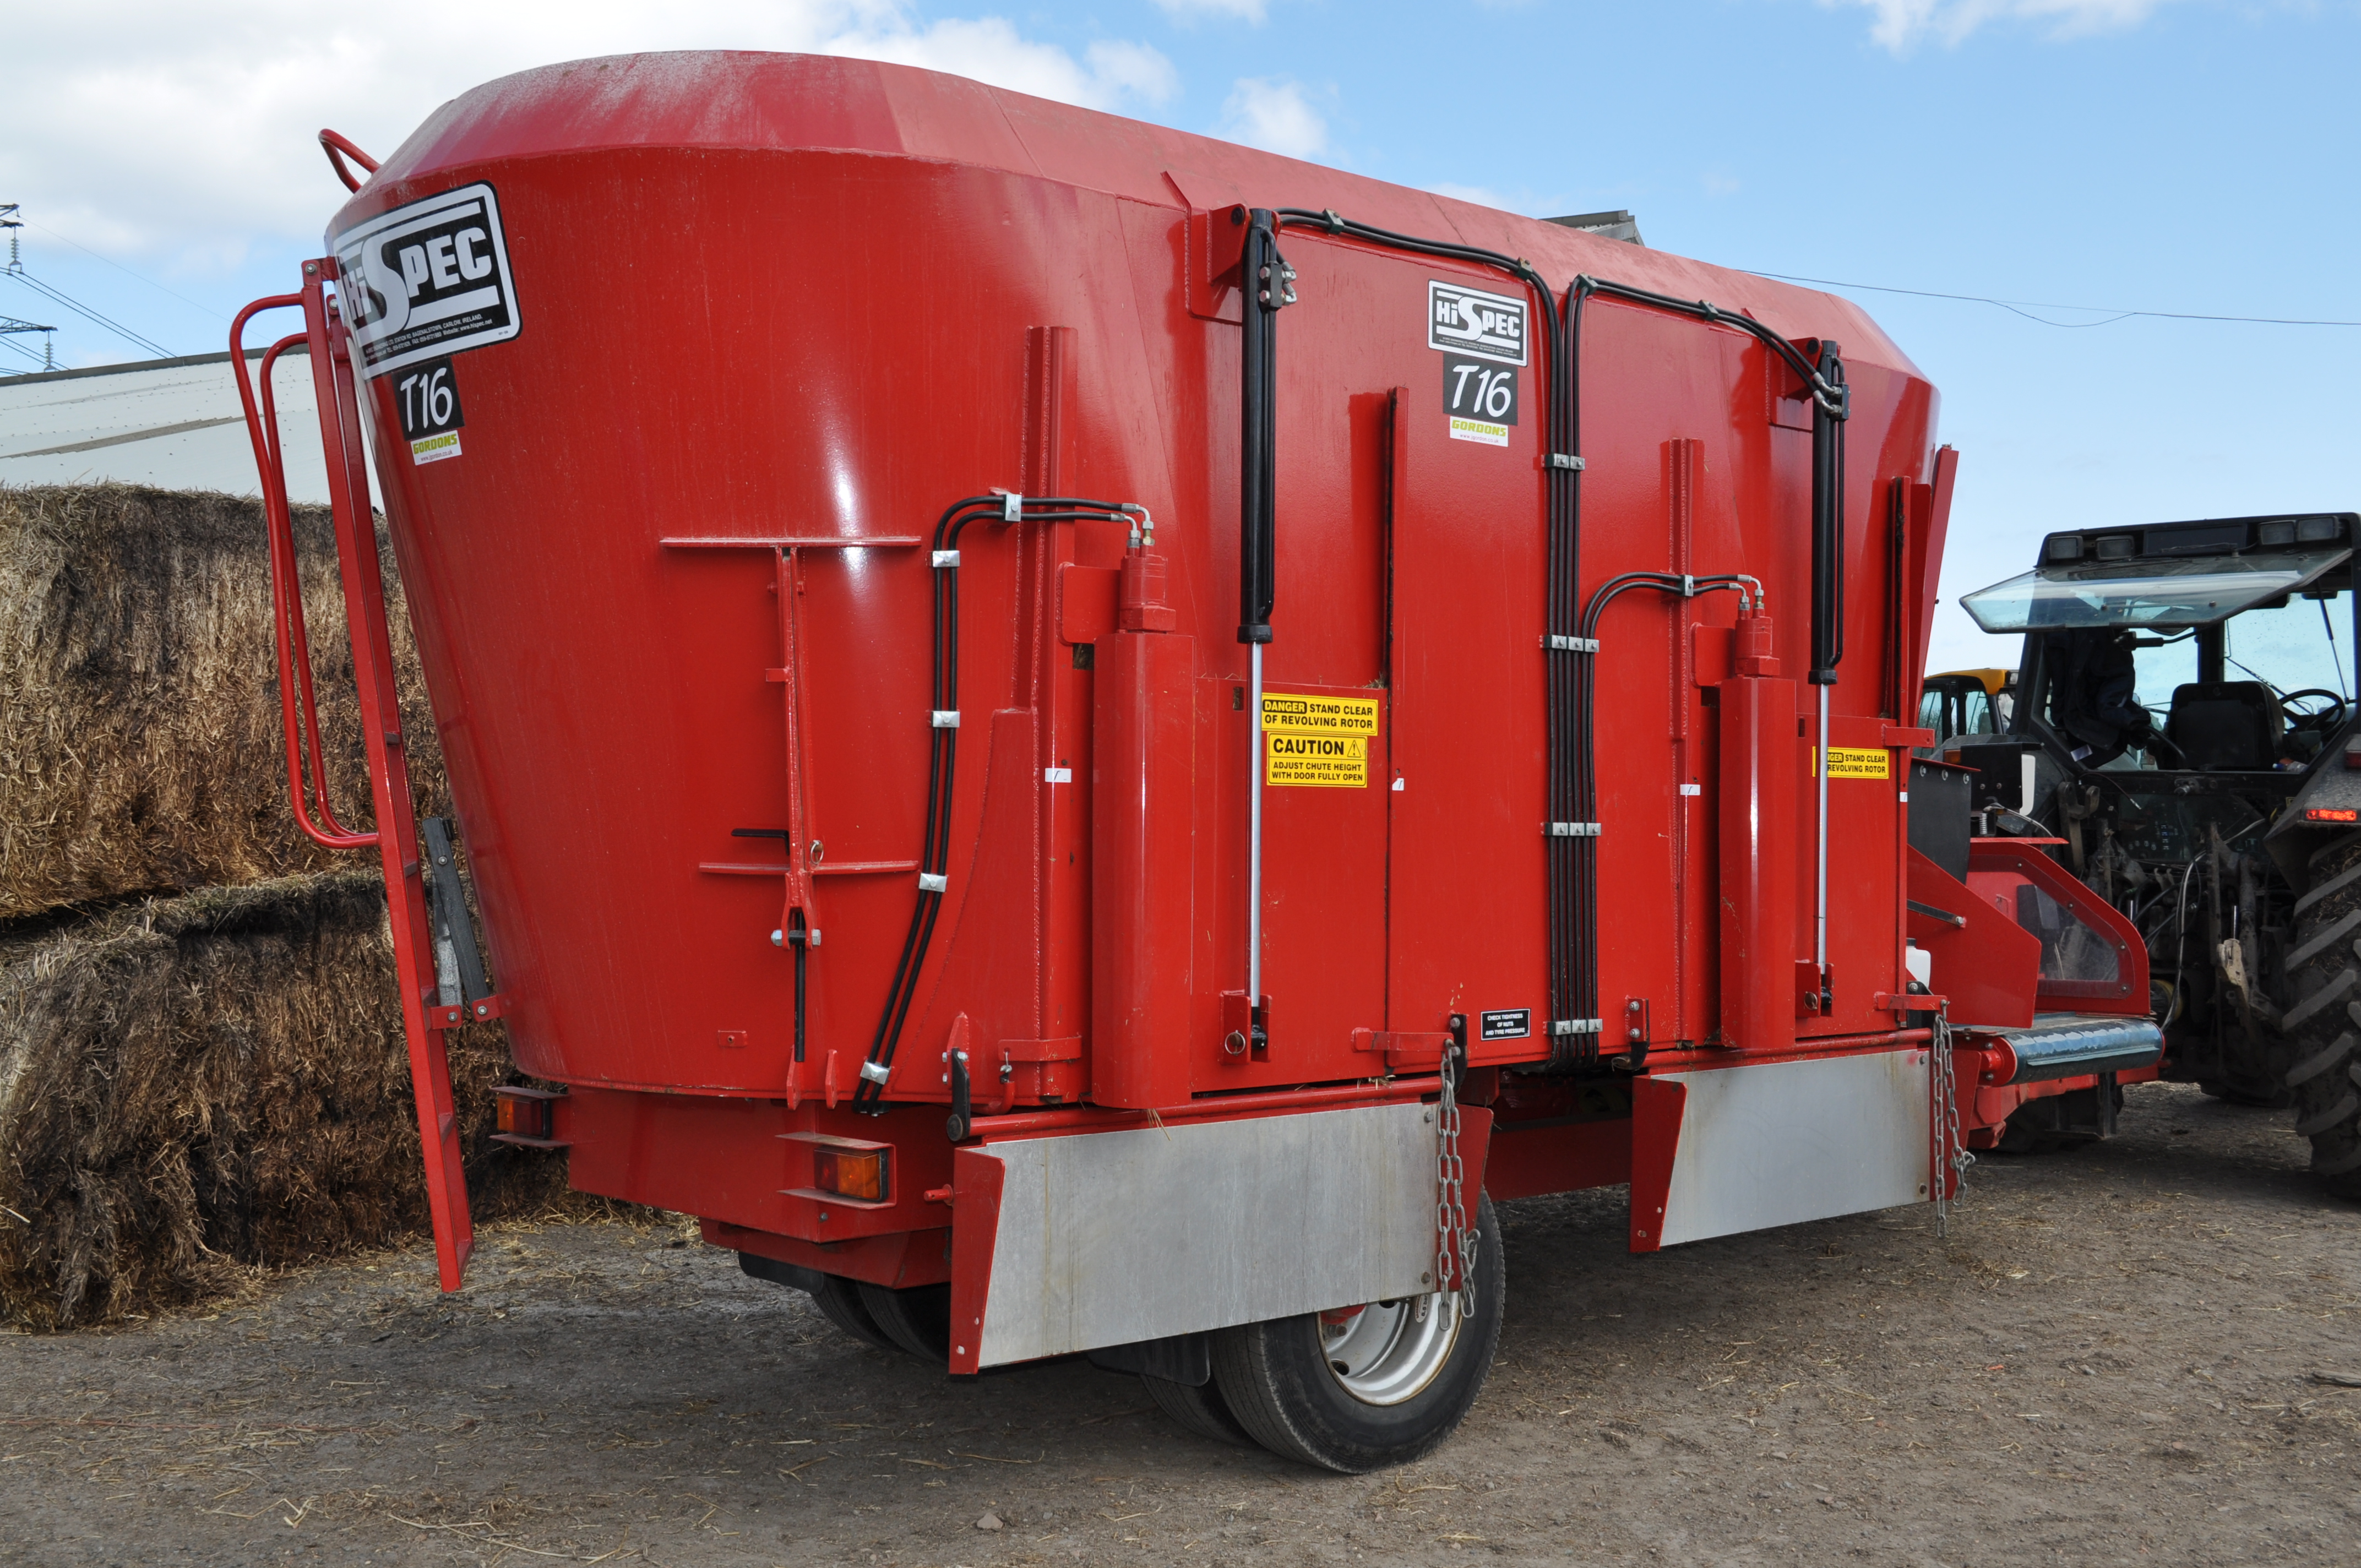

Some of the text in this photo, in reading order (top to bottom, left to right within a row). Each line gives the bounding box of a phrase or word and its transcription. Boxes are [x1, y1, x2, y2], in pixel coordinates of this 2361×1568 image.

[1452, 364, 1512, 417] T16
[400, 367, 453, 433] T16
[1451, 419, 1506, 437] GORDONS
[412, 433, 458, 455] GORDONS
[1460, 433, 1499, 444] www.jgordon.co.uk
[421, 449, 453, 462] www.jgordon.co.uk
[1264, 700, 1373, 716] DANGER STAND CLEAR
[1265, 714, 1373, 729] OF REVOLVING ROTOR
[1273, 738, 1344, 755] CAUTION
[1829, 753, 1886, 764] GER STAND CLEAR
[1274, 761, 1362, 772] ADJUST CHUTE HEIGHT
[1865, 765, 1886, 774] ROTOR
[1294, 772, 1315, 780] DOOR
[1318, 772, 1341, 781] FULLY
